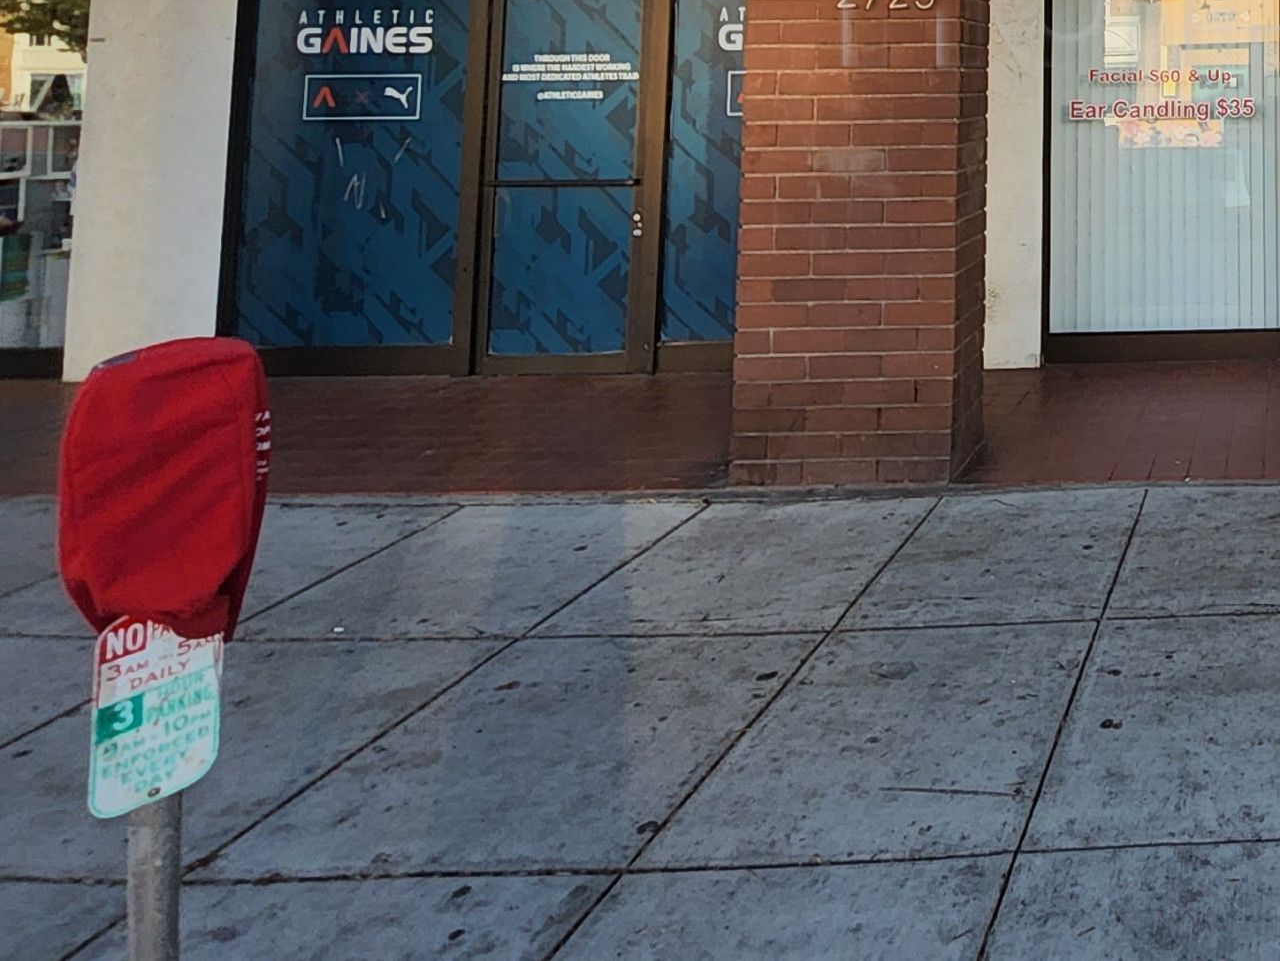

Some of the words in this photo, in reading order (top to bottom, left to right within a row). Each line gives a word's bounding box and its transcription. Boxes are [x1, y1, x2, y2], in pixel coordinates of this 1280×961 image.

[299, 9, 435, 25] ATHLETIC
[296, 26, 434, 55] GAINES
[1089, 69, 1143, 83] Facial
[1188, 69, 1200, 82] &
[1208, 68, 1232, 84] Up
[1069, 101, 1108, 119] Ear
[1112, 99, 1210, 121] Candling
[1216, 98, 1255, 119] $35
[106, 622, 145, 660] NO
[131, 660, 190, 690] DAILY
[112, 699, 134, 731] 3
[102, 725, 210, 779] ENFORCED
[120, 749, 188, 785] EVERY
[134, 766, 176, 794] DAY
